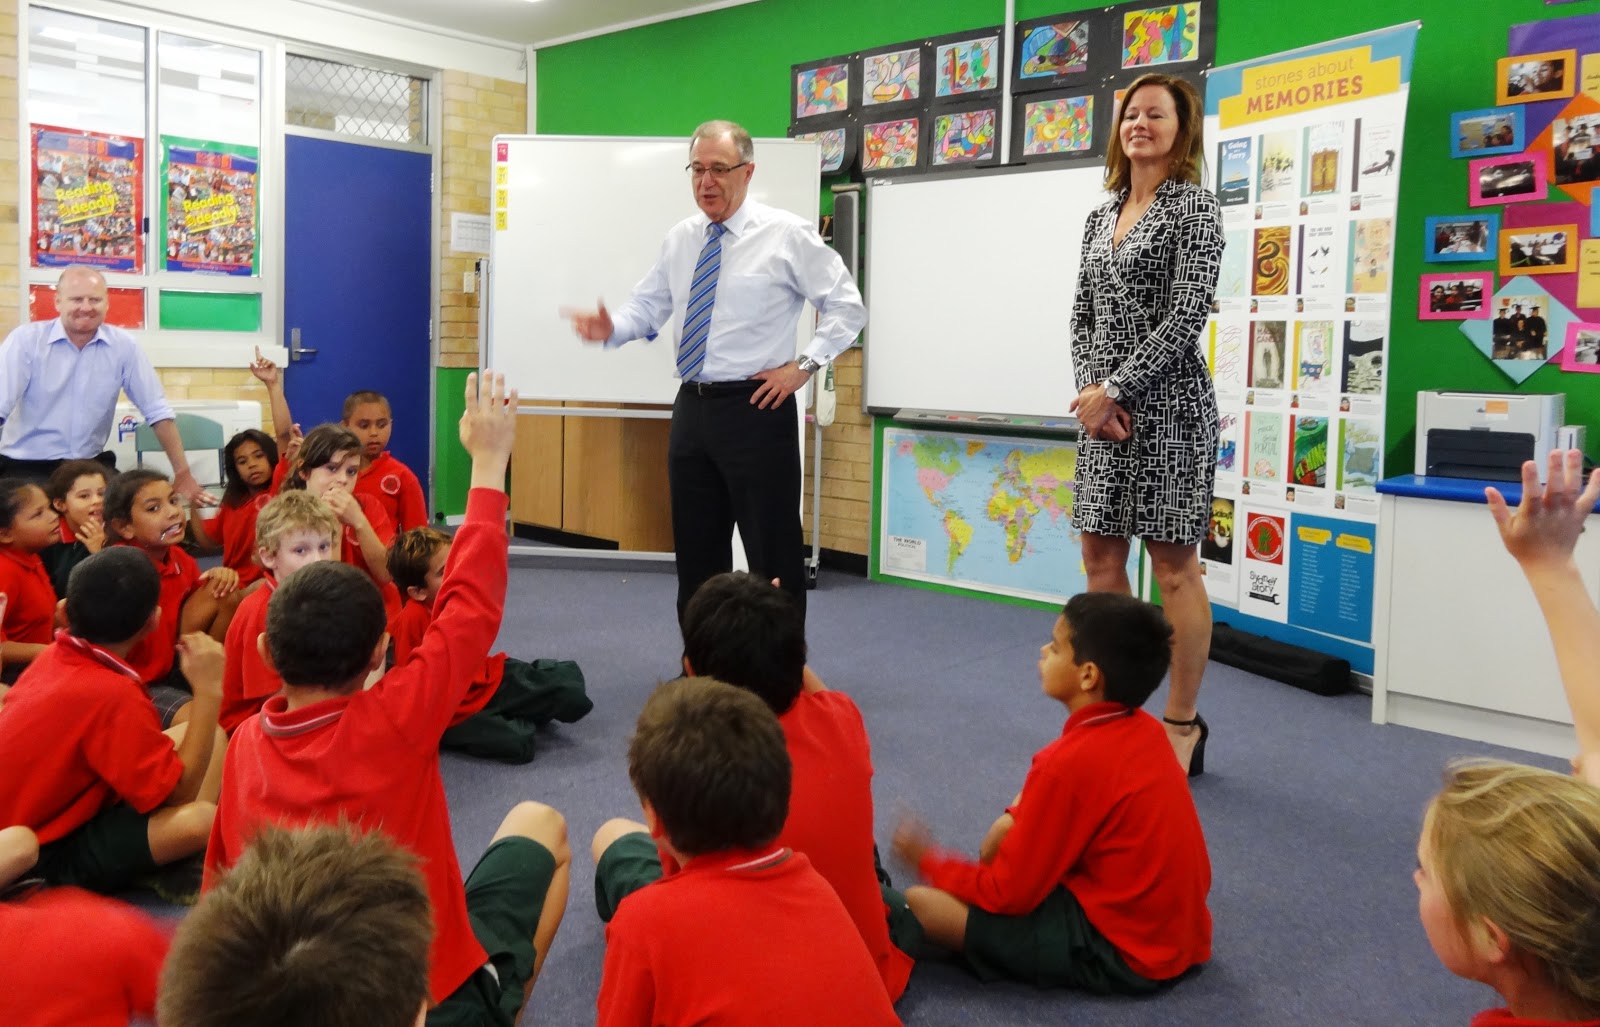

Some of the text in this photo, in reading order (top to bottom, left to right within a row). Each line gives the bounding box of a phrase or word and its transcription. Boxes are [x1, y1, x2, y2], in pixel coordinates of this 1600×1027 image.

[1255, 58, 1355, 91] stories about
[1246, 75, 1363, 115] MEMORIES
[55, 181, 113, 201] Reading
[183, 193, 235, 212] Reading
[1249, 570, 1278, 585] Sydney
[1251, 582, 1275, 595] Story
